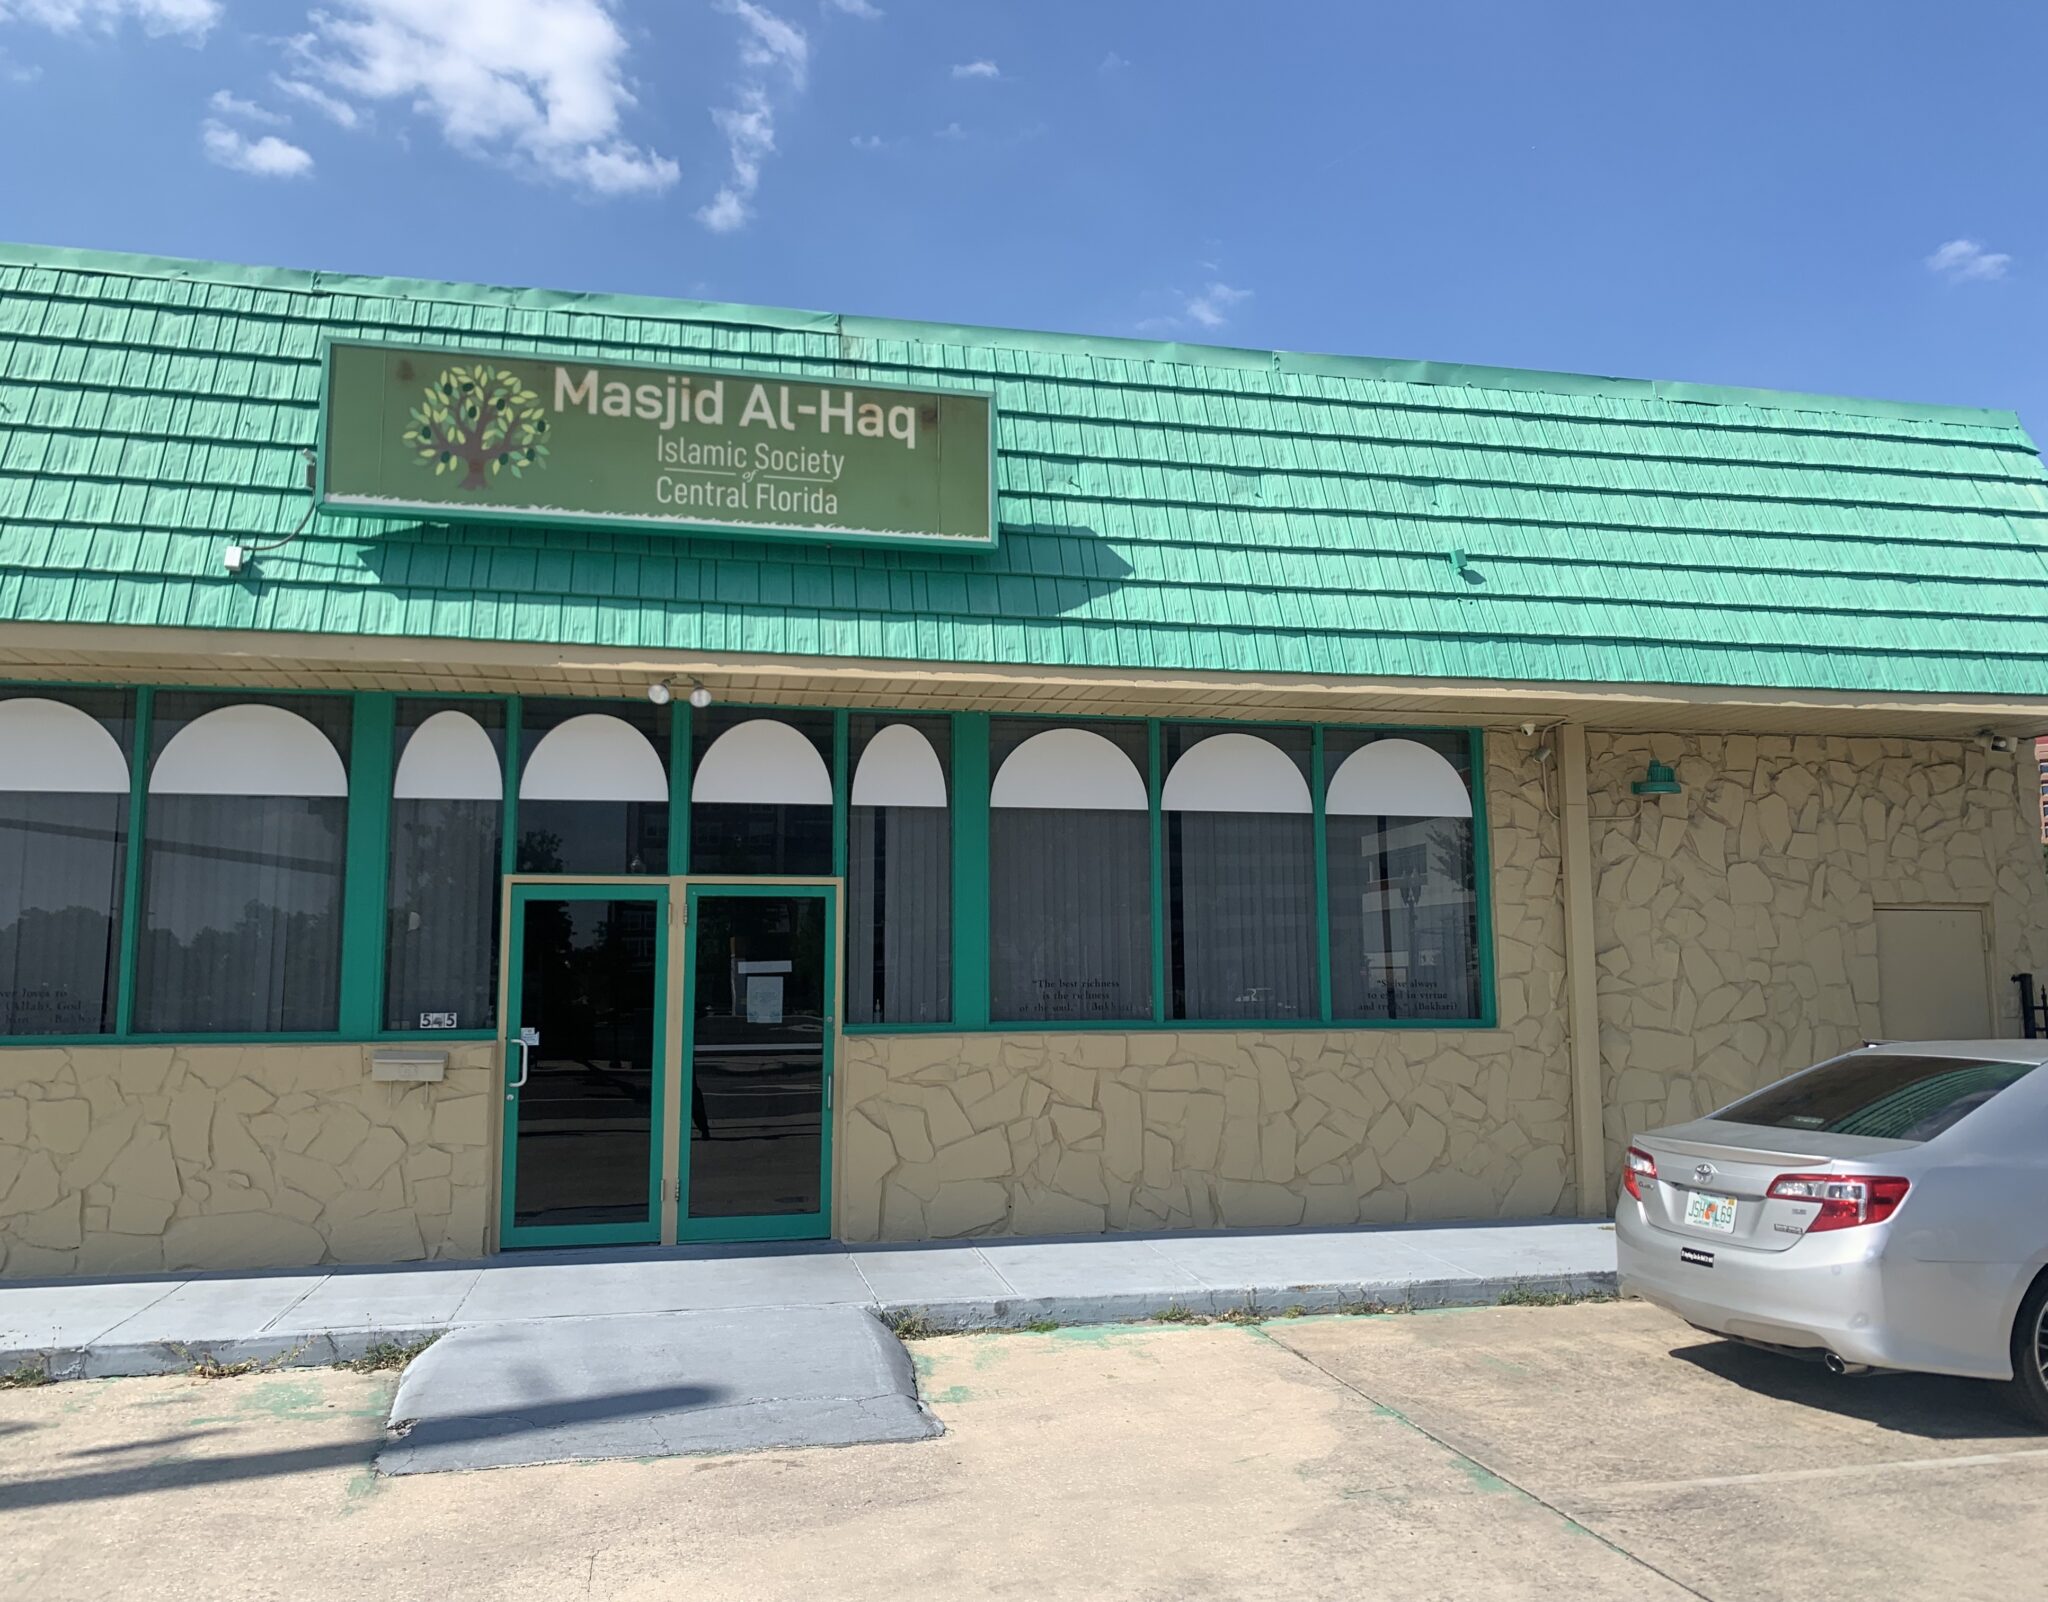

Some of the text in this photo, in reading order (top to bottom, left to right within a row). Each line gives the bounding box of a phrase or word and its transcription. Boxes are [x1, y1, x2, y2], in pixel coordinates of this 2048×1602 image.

[553, 367, 916, 450] Masjid Al-Haq
[657, 434, 846, 480] Islamic Society
[741, 469, 758, 483] of
[656, 476, 839, 515] Central Florida
[1060, 978, 1078, 988] best
[1081, 978, 1120, 988] richness
[1410, 978, 1438, 989] always
[1042, 990, 1110, 1001] is the richness
[1367, 991, 1377, 999] to
[1407, 989, 1416, 999] in
[1420, 991, 1448, 999] virtue
[57, 1000, 81, 1010] God
[1019, 1003, 1028, 1012] of
[1034, 1002, 1048, 1012] the
[1359, 1002, 1374, 1011] and
